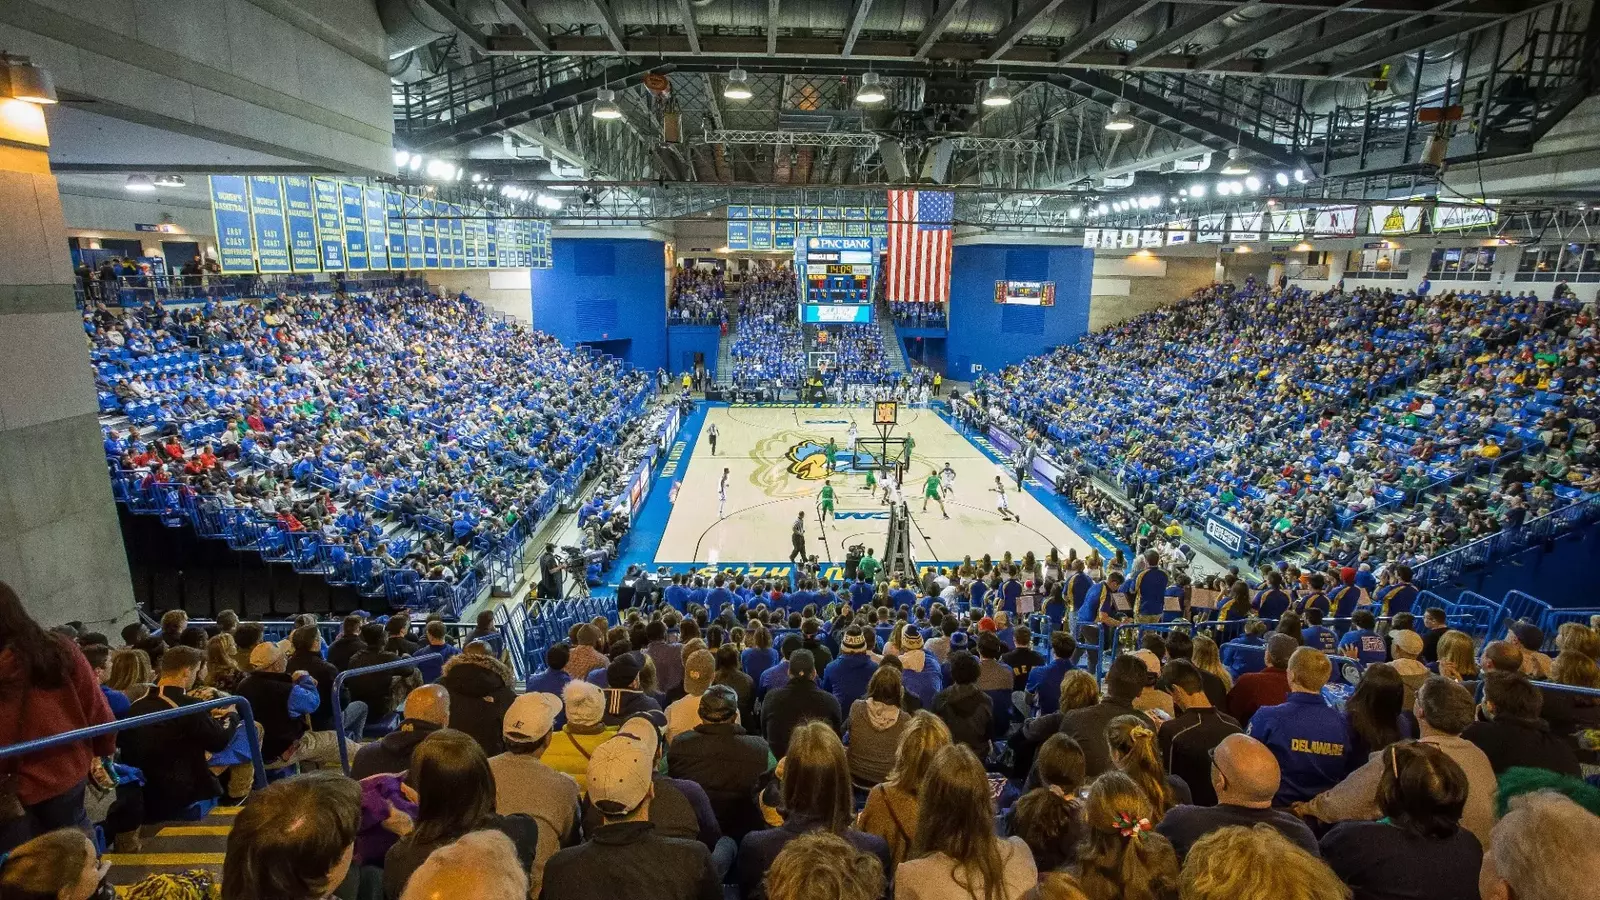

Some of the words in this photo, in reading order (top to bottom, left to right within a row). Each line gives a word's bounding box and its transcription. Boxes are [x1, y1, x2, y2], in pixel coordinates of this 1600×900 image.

[821, 240, 842, 248] PNC
[843, 240, 871, 248] BANK
[830, 266, 851, 274] 14:09
[1291, 738, 1344, 755] DELAWARE
